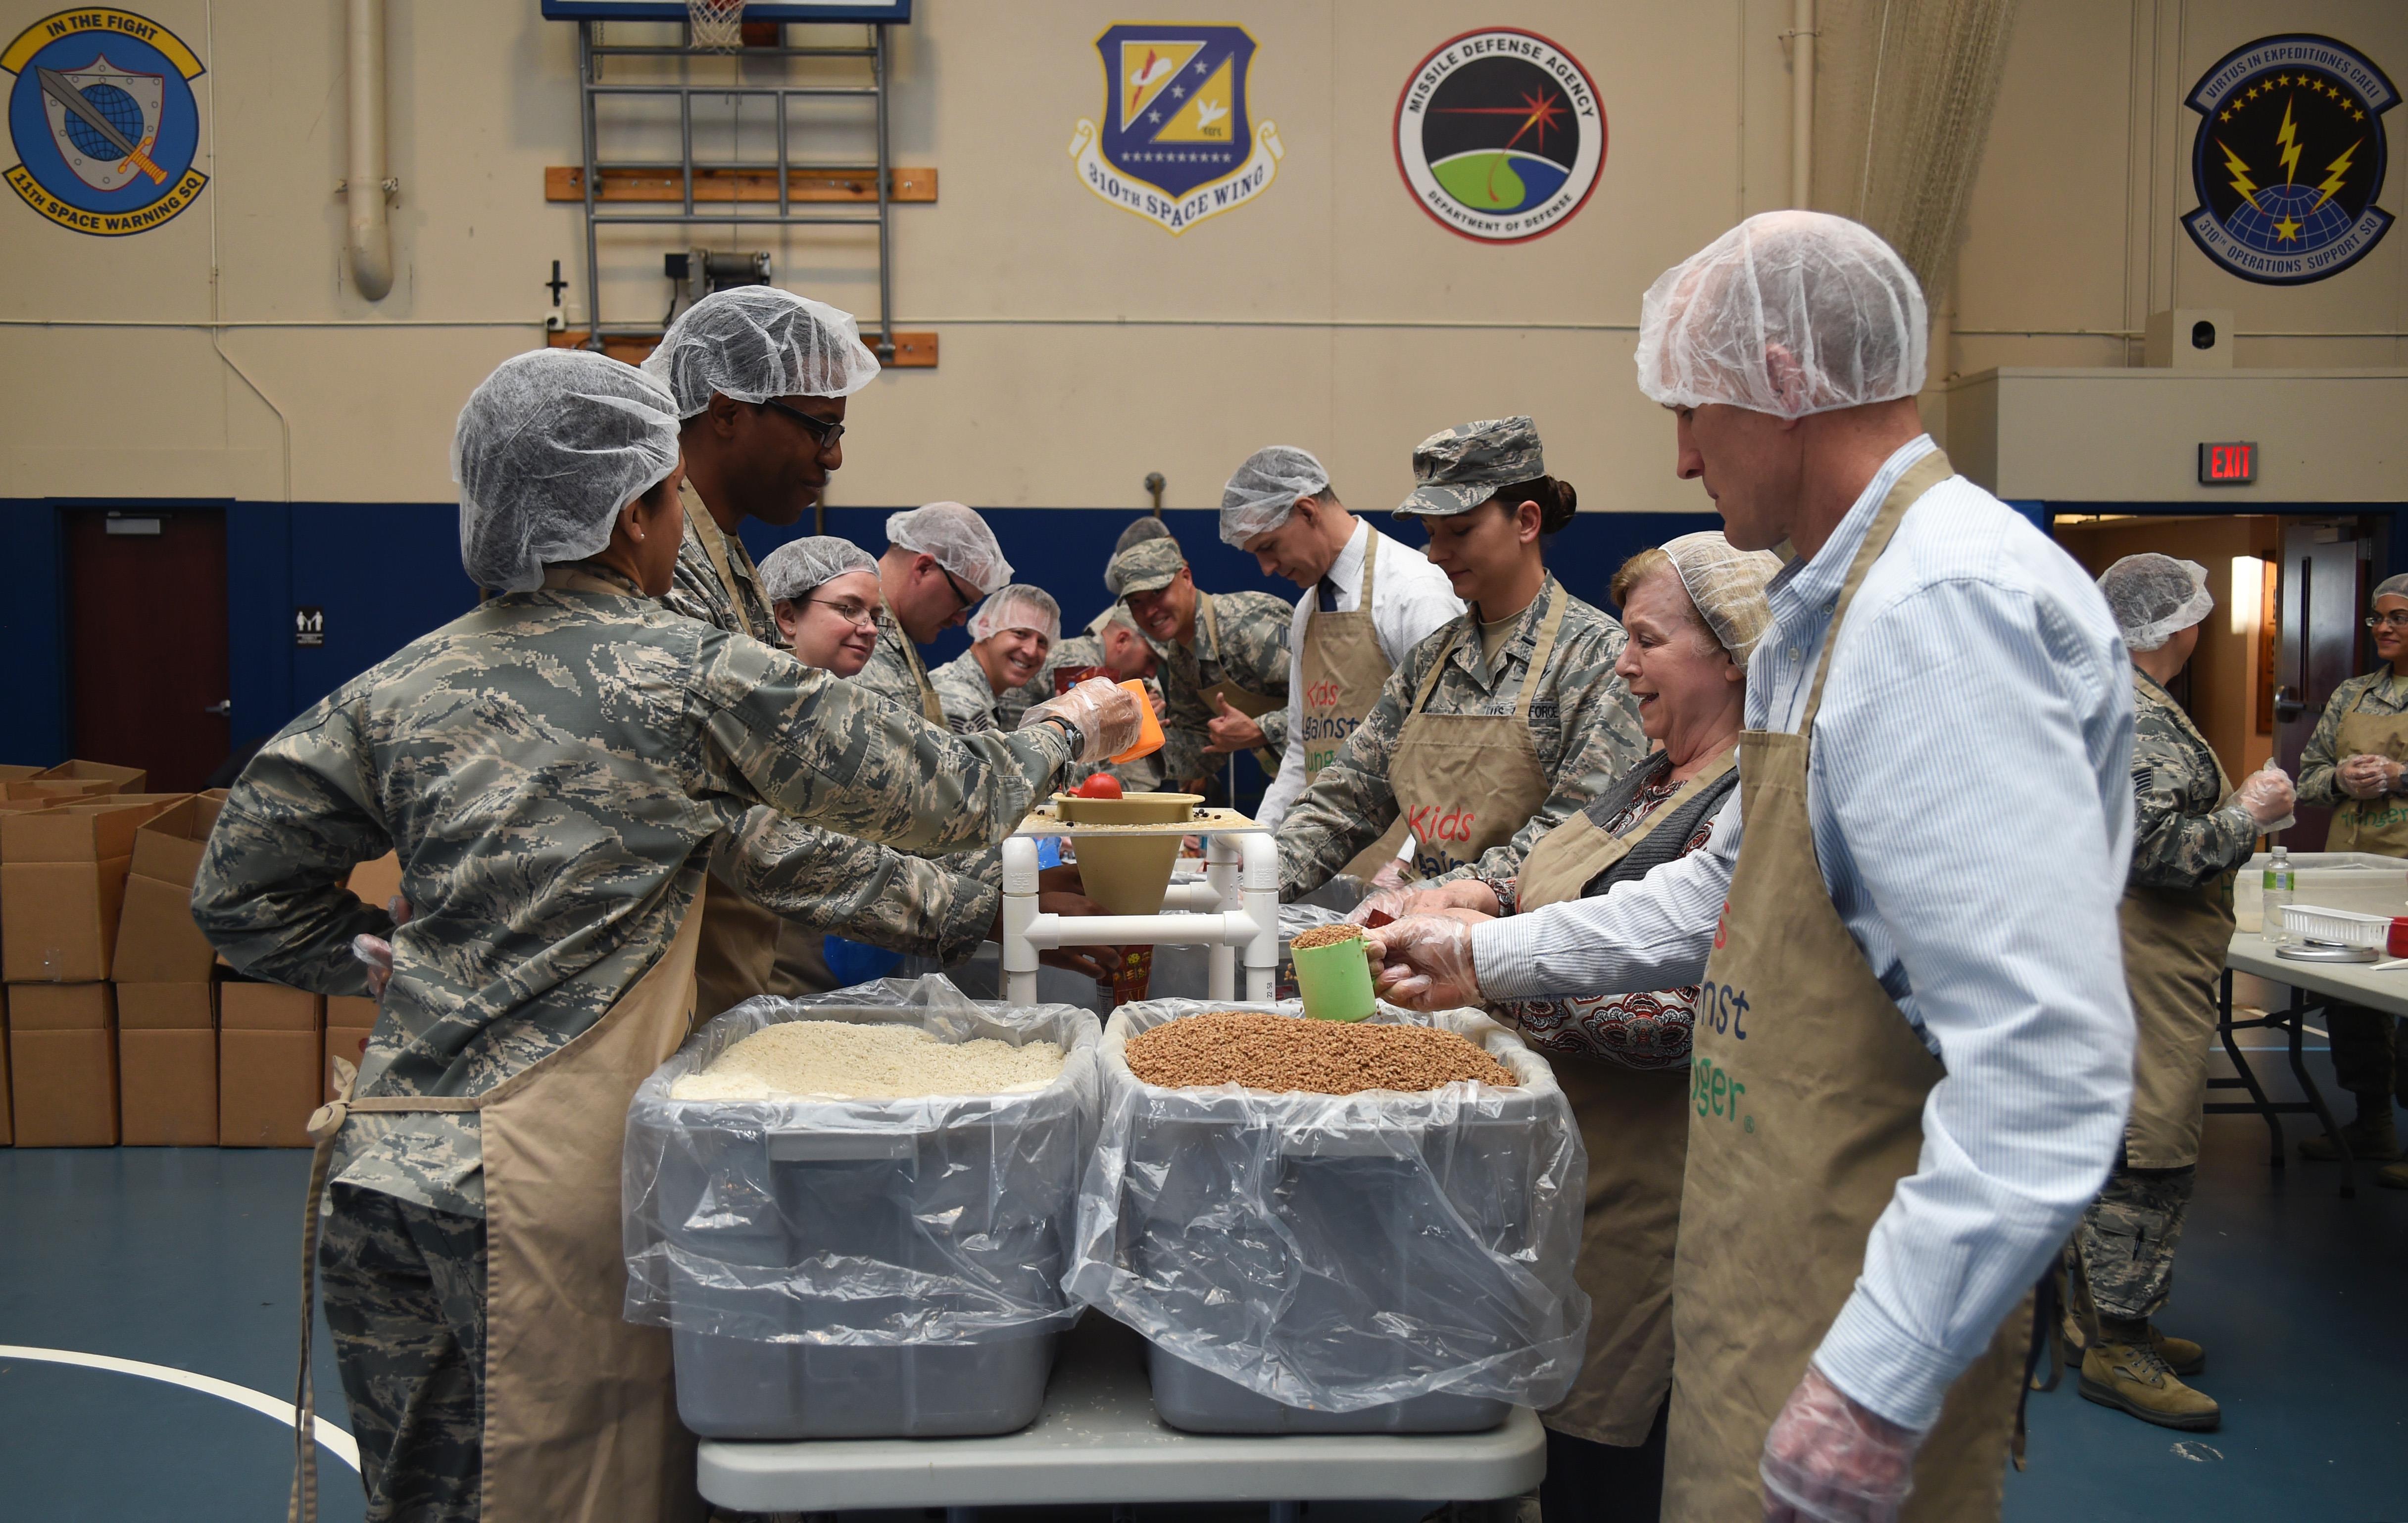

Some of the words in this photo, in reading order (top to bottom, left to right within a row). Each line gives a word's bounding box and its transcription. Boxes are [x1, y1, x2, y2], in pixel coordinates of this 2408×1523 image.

[47, 20, 66, 37] IN
[68, 14, 102, 30] THE
[107, 15, 158, 41] FIGHT
[1409, 52, 1459, 114] MISSILE
[1462, 39, 1543, 59] DEFENSE
[1546, 56, 1594, 118] AGENCY
[2206, 62, 2247, 98] VIRTUS
[2248, 54, 2262, 68] IN
[2265, 48, 2351, 73] EXPEDITIONES
[2350, 68, 2380, 98] CAELI
[14, 173, 45, 206] 11TH
[48, 201, 100, 229] SPACE
[105, 198, 182, 230] WARNING
[179, 177, 201, 199] SQ
[1089, 162, 1140, 206] 310TH
[1147, 195, 1209, 227] SPACE
[1215, 165, 1264, 206] WING
[1428, 190, 1500, 231] DEPARTMENT
[1506, 222, 1520, 232] OF
[1525, 193, 1572, 228] DEFENSE
[2227, 245, 2302, 273] OPERATIONS
[2308, 234, 2361, 269] SUPPORT
[2359, 217, 2379, 236] SQ
[2211, 446, 2251, 477] EXIT
[1302, 714, 1360, 741] gainst
[1528, 705, 1559, 717] FORCE
[1409, 804, 1474, 844] Kids
